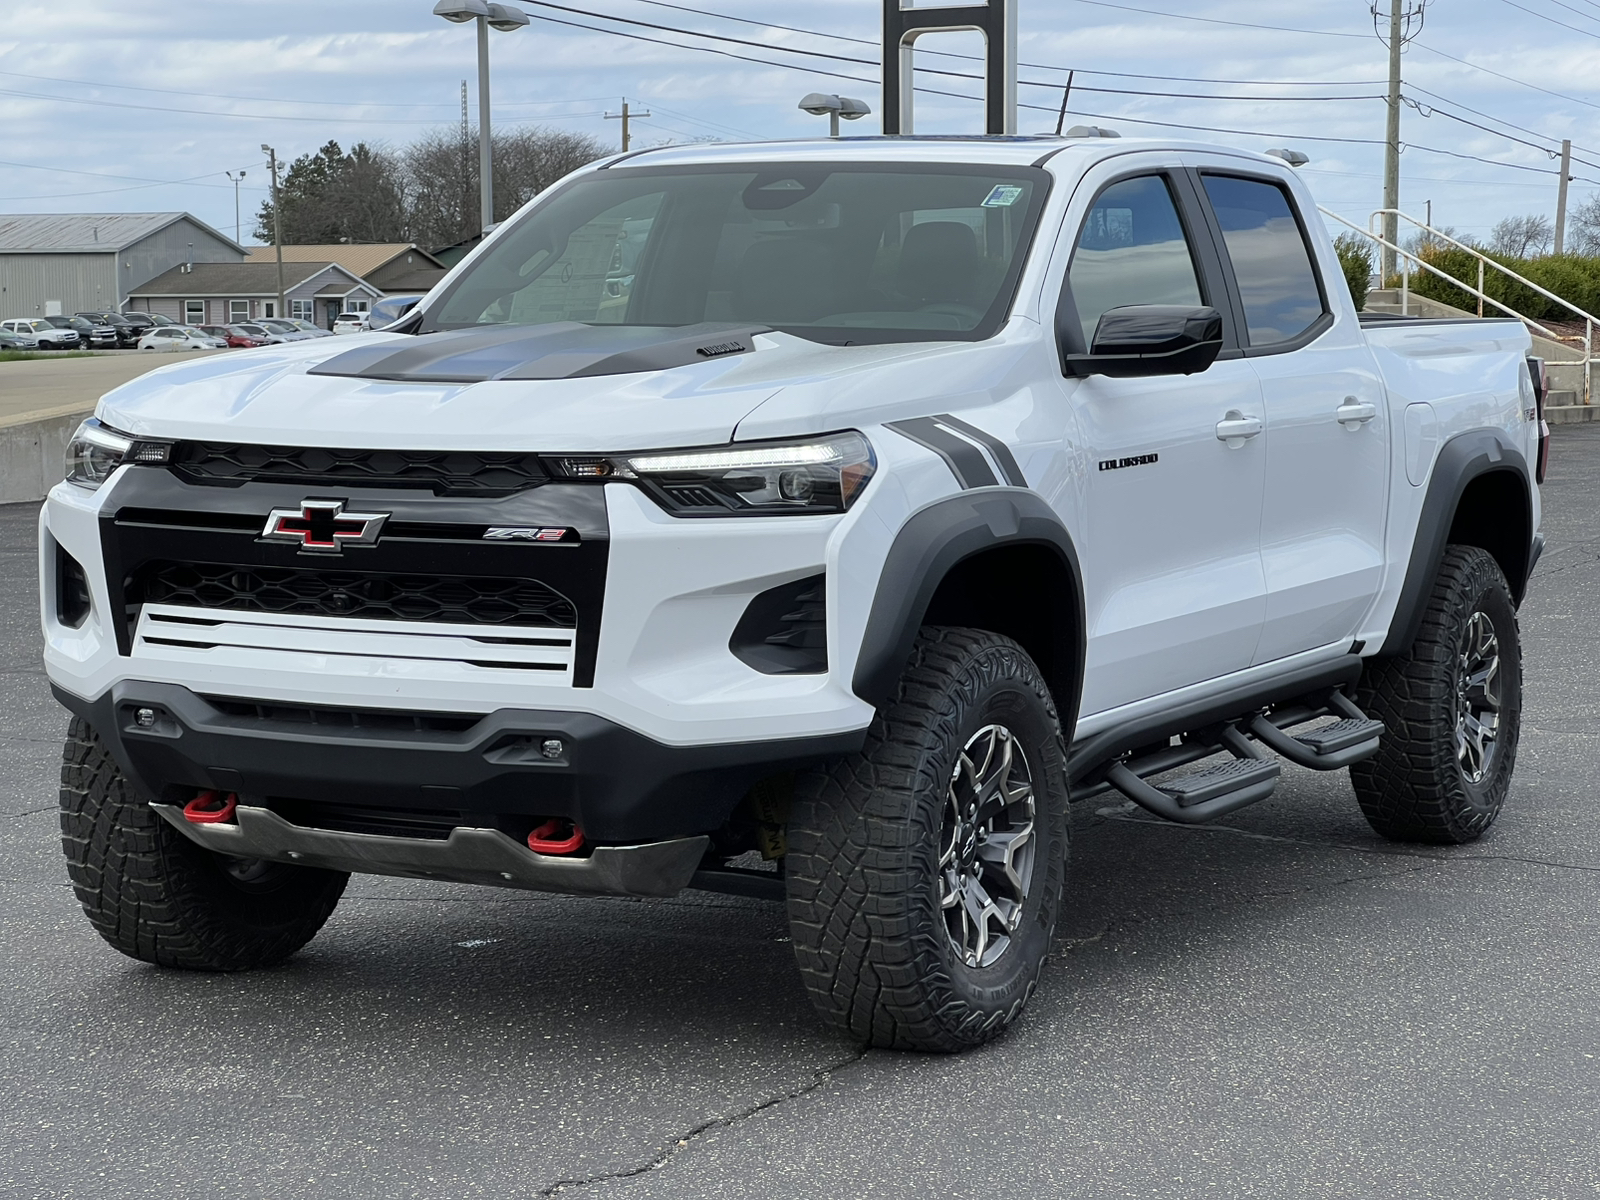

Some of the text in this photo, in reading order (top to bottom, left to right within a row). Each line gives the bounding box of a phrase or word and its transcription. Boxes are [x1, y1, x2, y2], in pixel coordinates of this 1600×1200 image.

[1099, 453, 1159, 471] COLORADO
[482, 527, 568, 541] ZR2
[1034, 734, 1062, 931] WRANGLER
